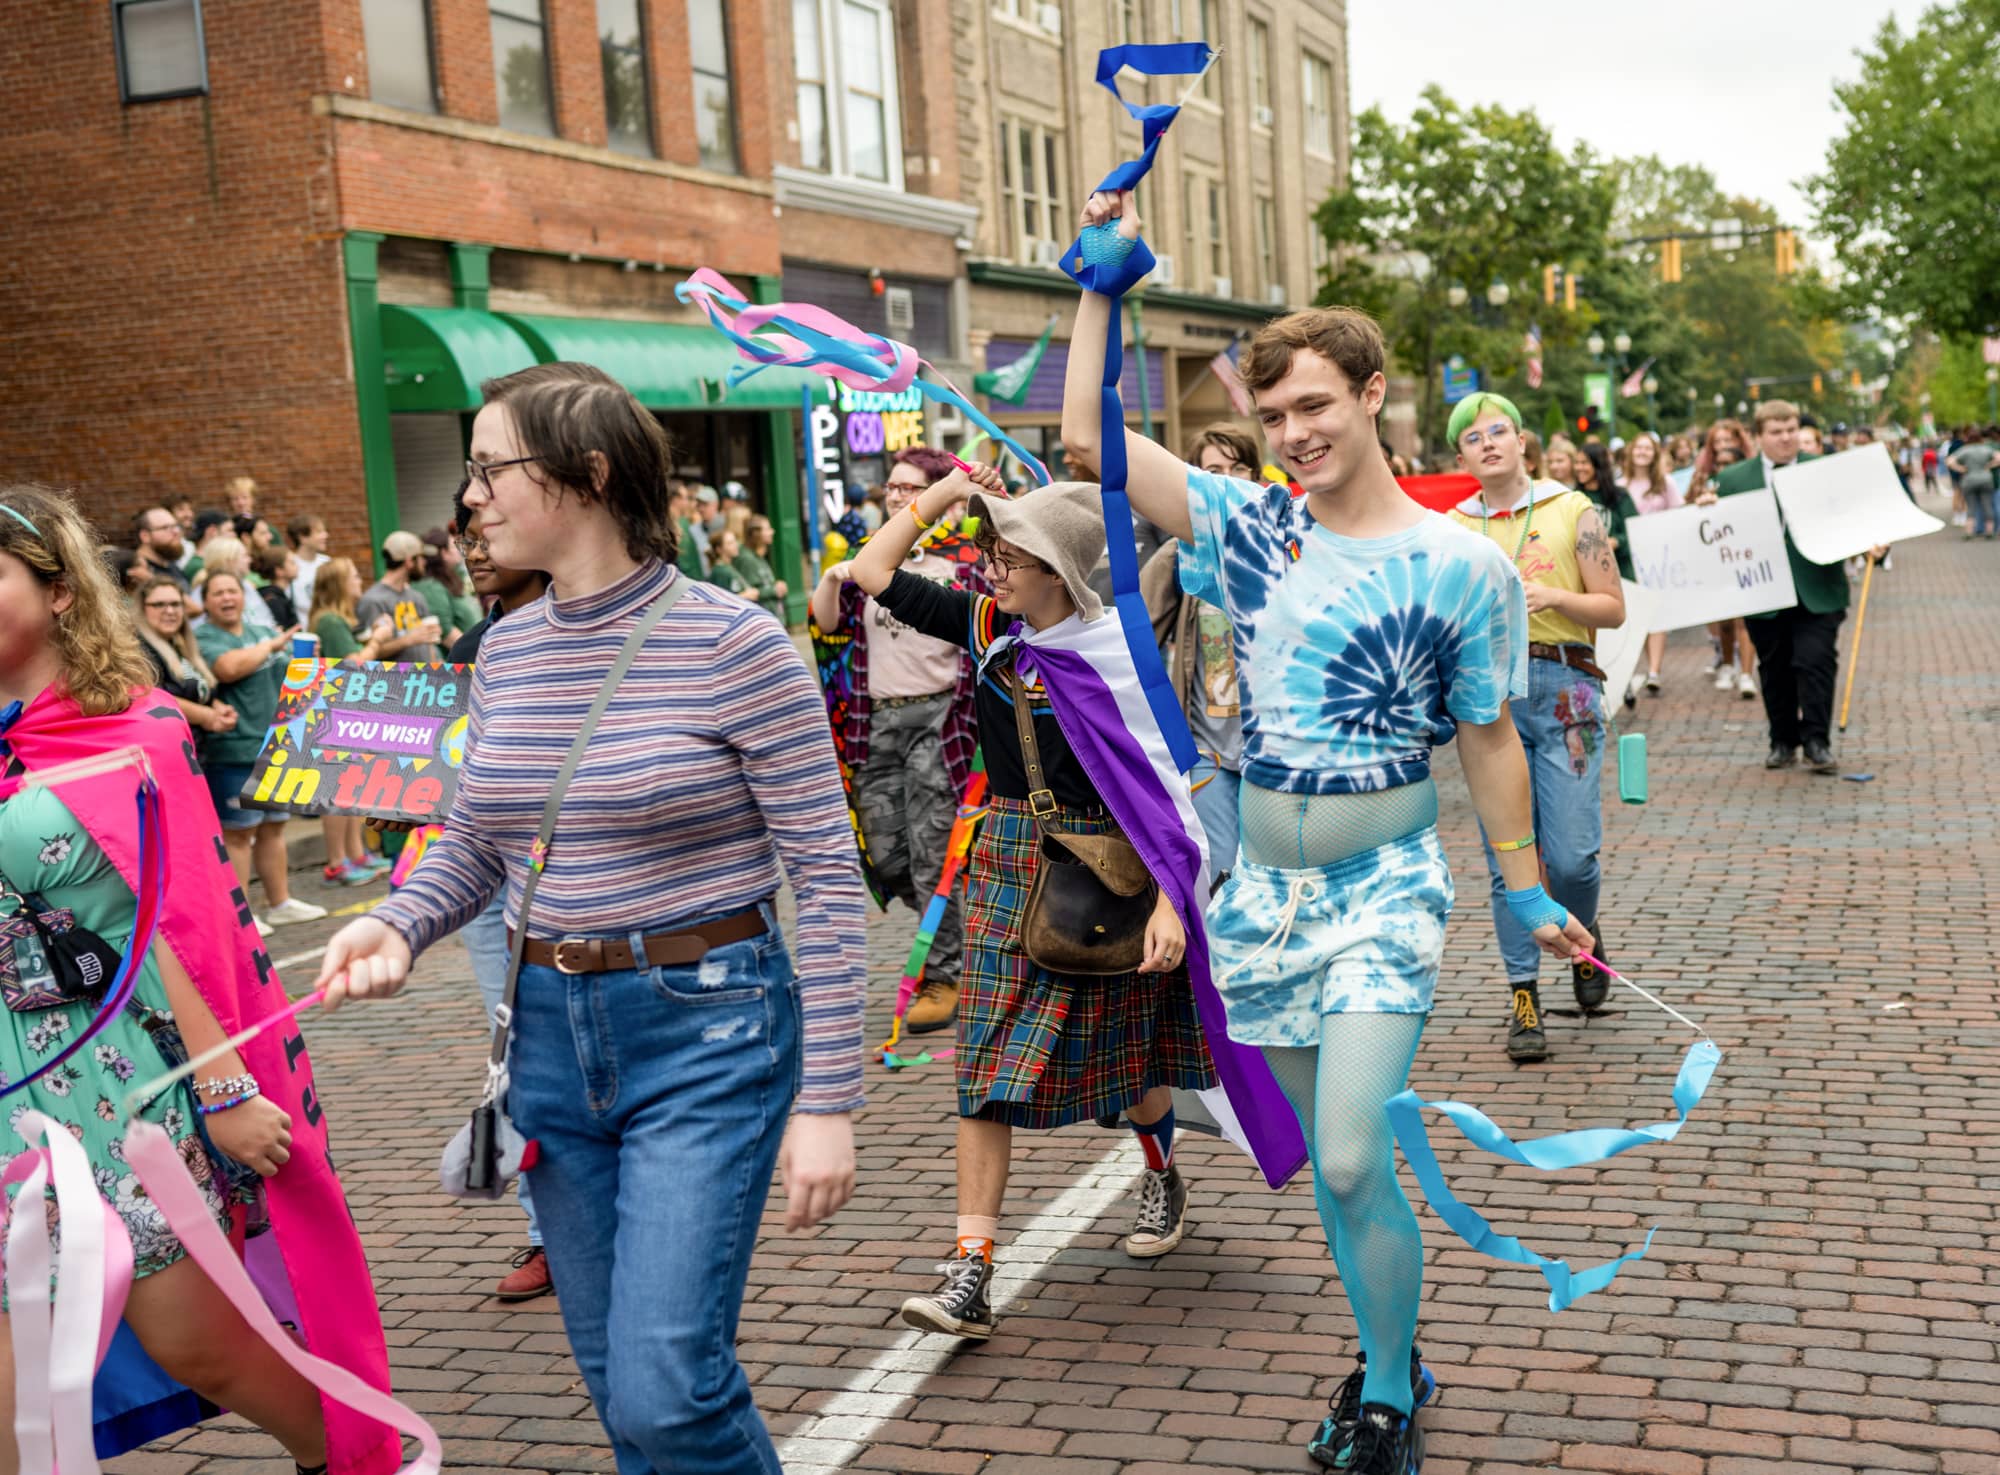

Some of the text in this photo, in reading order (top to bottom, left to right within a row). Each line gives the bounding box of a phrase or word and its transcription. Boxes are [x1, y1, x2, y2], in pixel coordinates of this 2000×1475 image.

[1699, 519, 1735, 546] Can
[1720, 545, 1753, 563] Are
[1736, 560, 1774, 589] Will
[343, 672, 458, 708] Be the
[337, 719, 433, 746] YOU WISH
[253, 749, 443, 815] in the
[75, 952, 103, 985] OHIO
